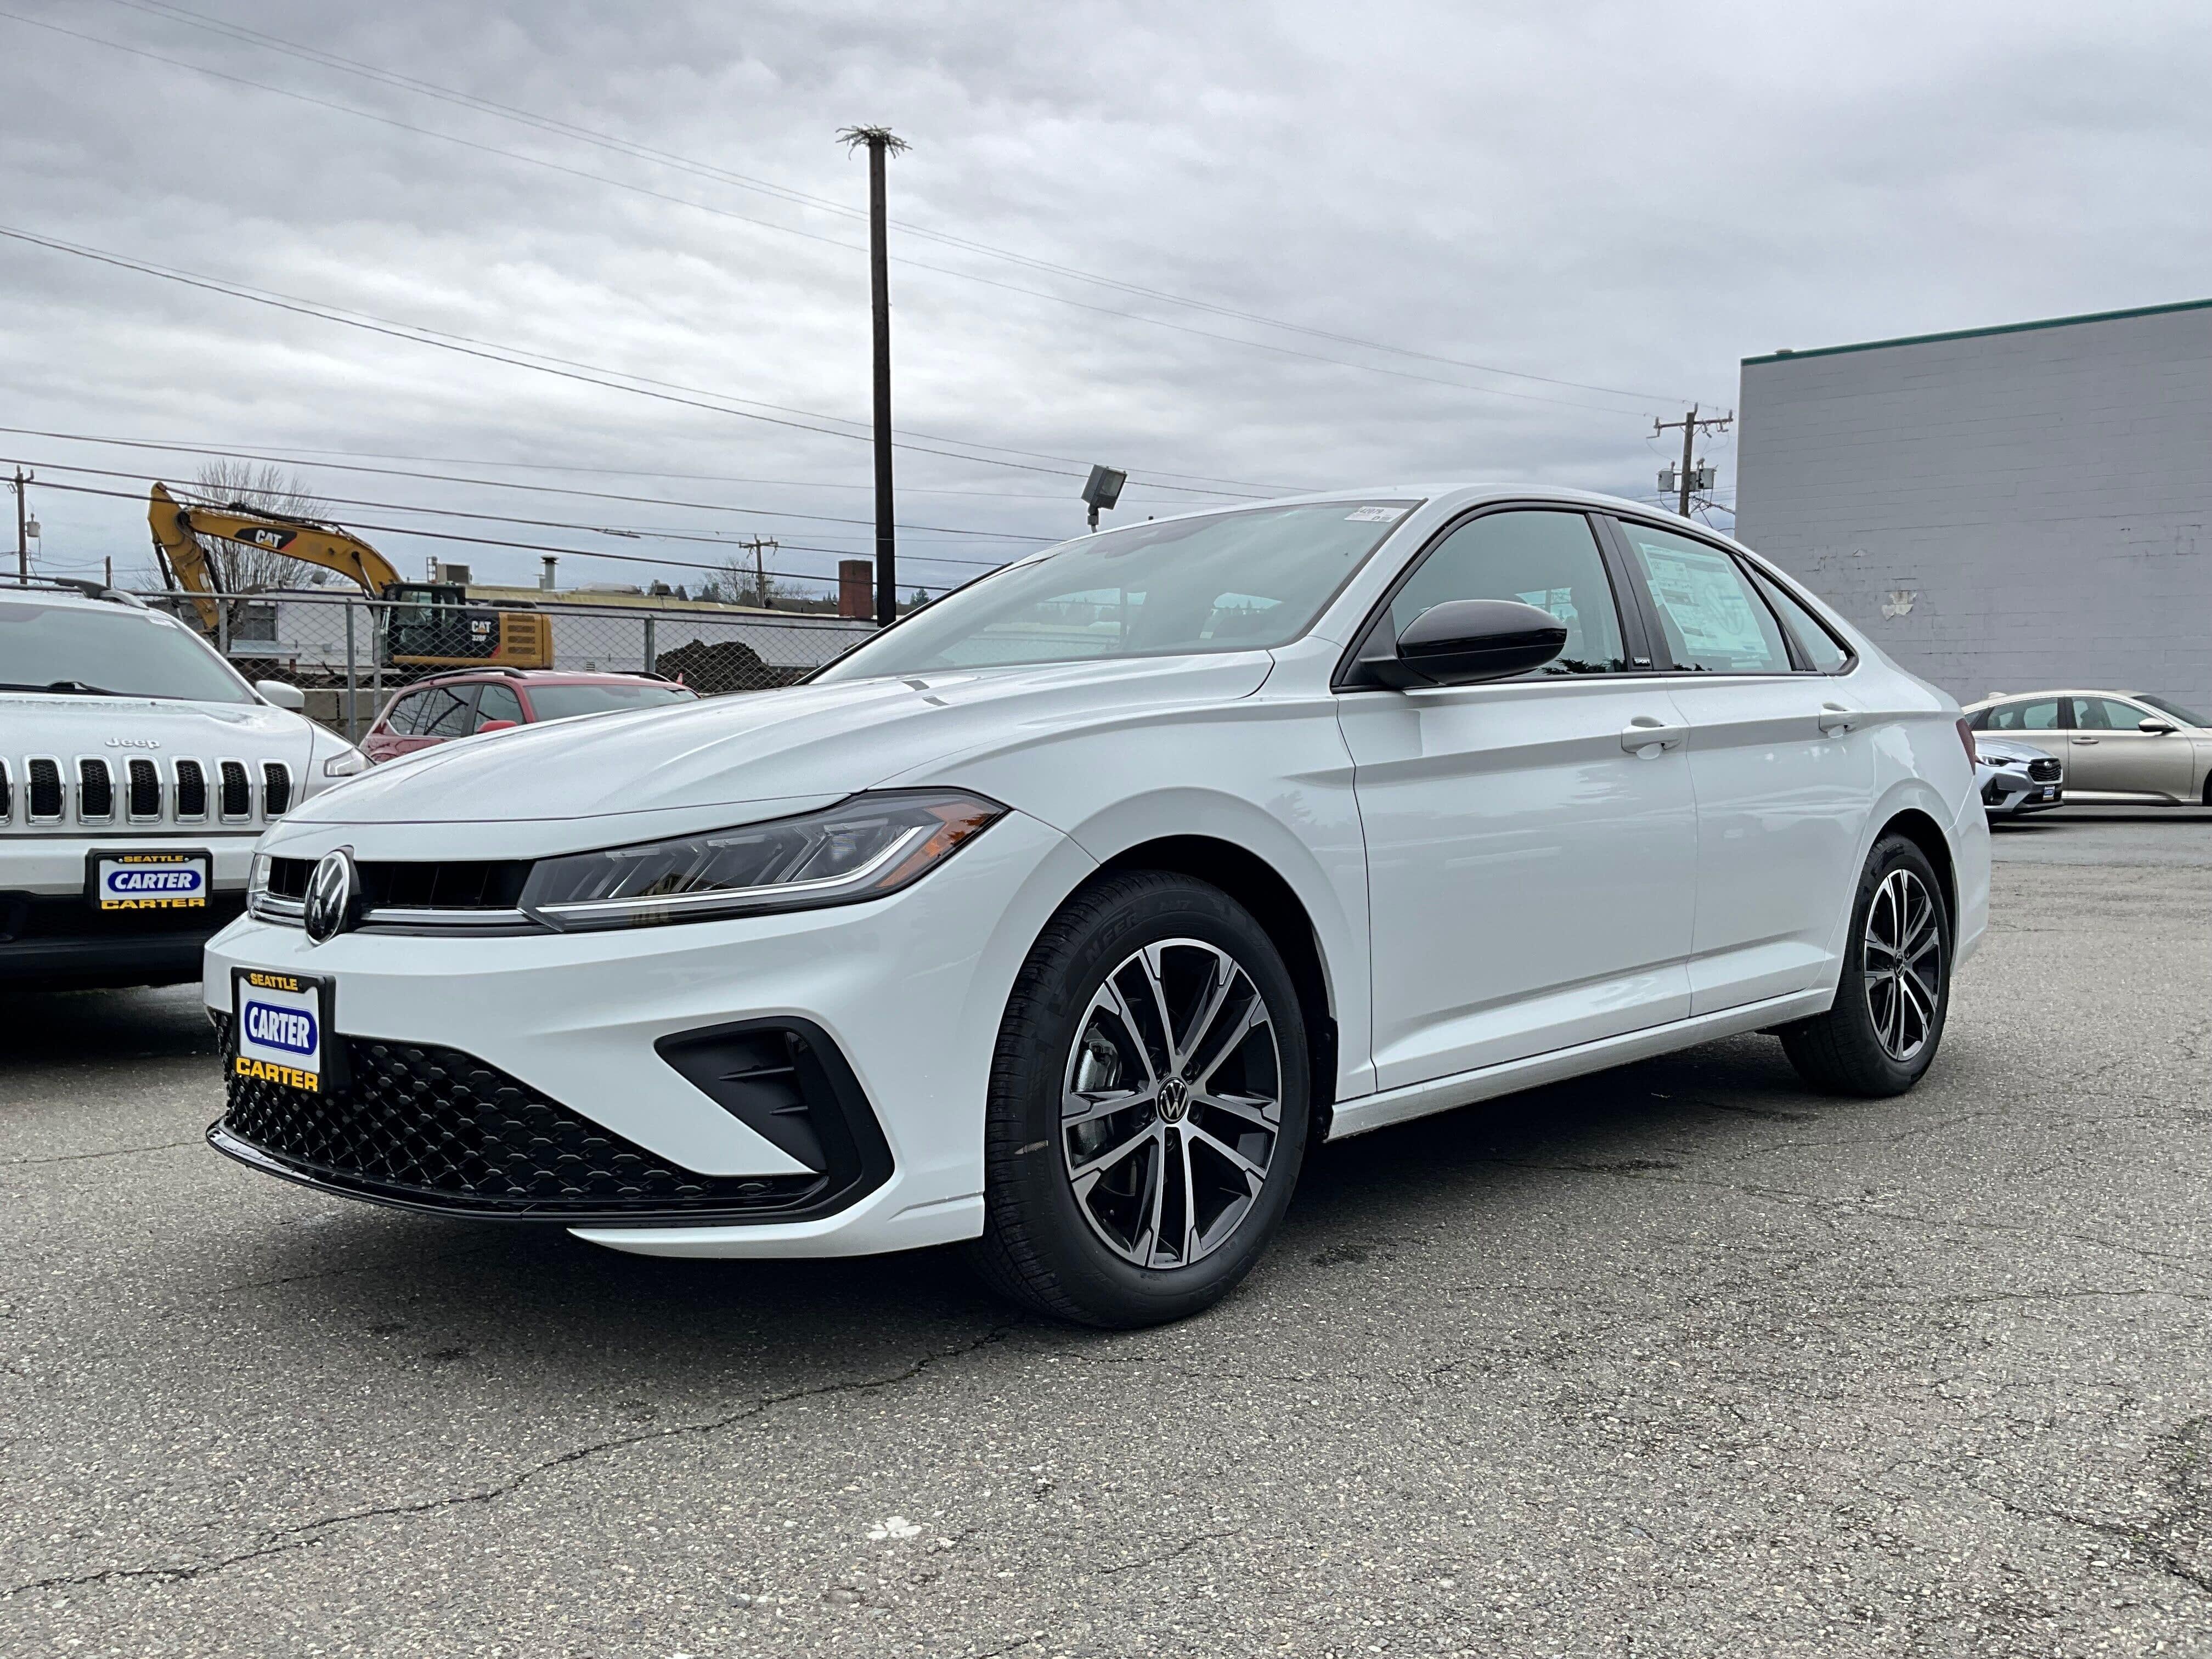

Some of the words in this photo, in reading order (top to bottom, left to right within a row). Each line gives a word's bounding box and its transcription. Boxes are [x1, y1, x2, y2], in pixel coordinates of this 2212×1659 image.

[255, 529, 282, 548] CAT
[472, 620, 491, 633] CAT
[105, 737, 160, 749] Jeep
[115, 873, 193, 889] CARTER
[101, 898, 205, 910] CARTER
[250, 973, 298, 991] SEATTLE
[249, 1006, 310, 1048] CARTER
[236, 1057, 318, 1092] CARTER
